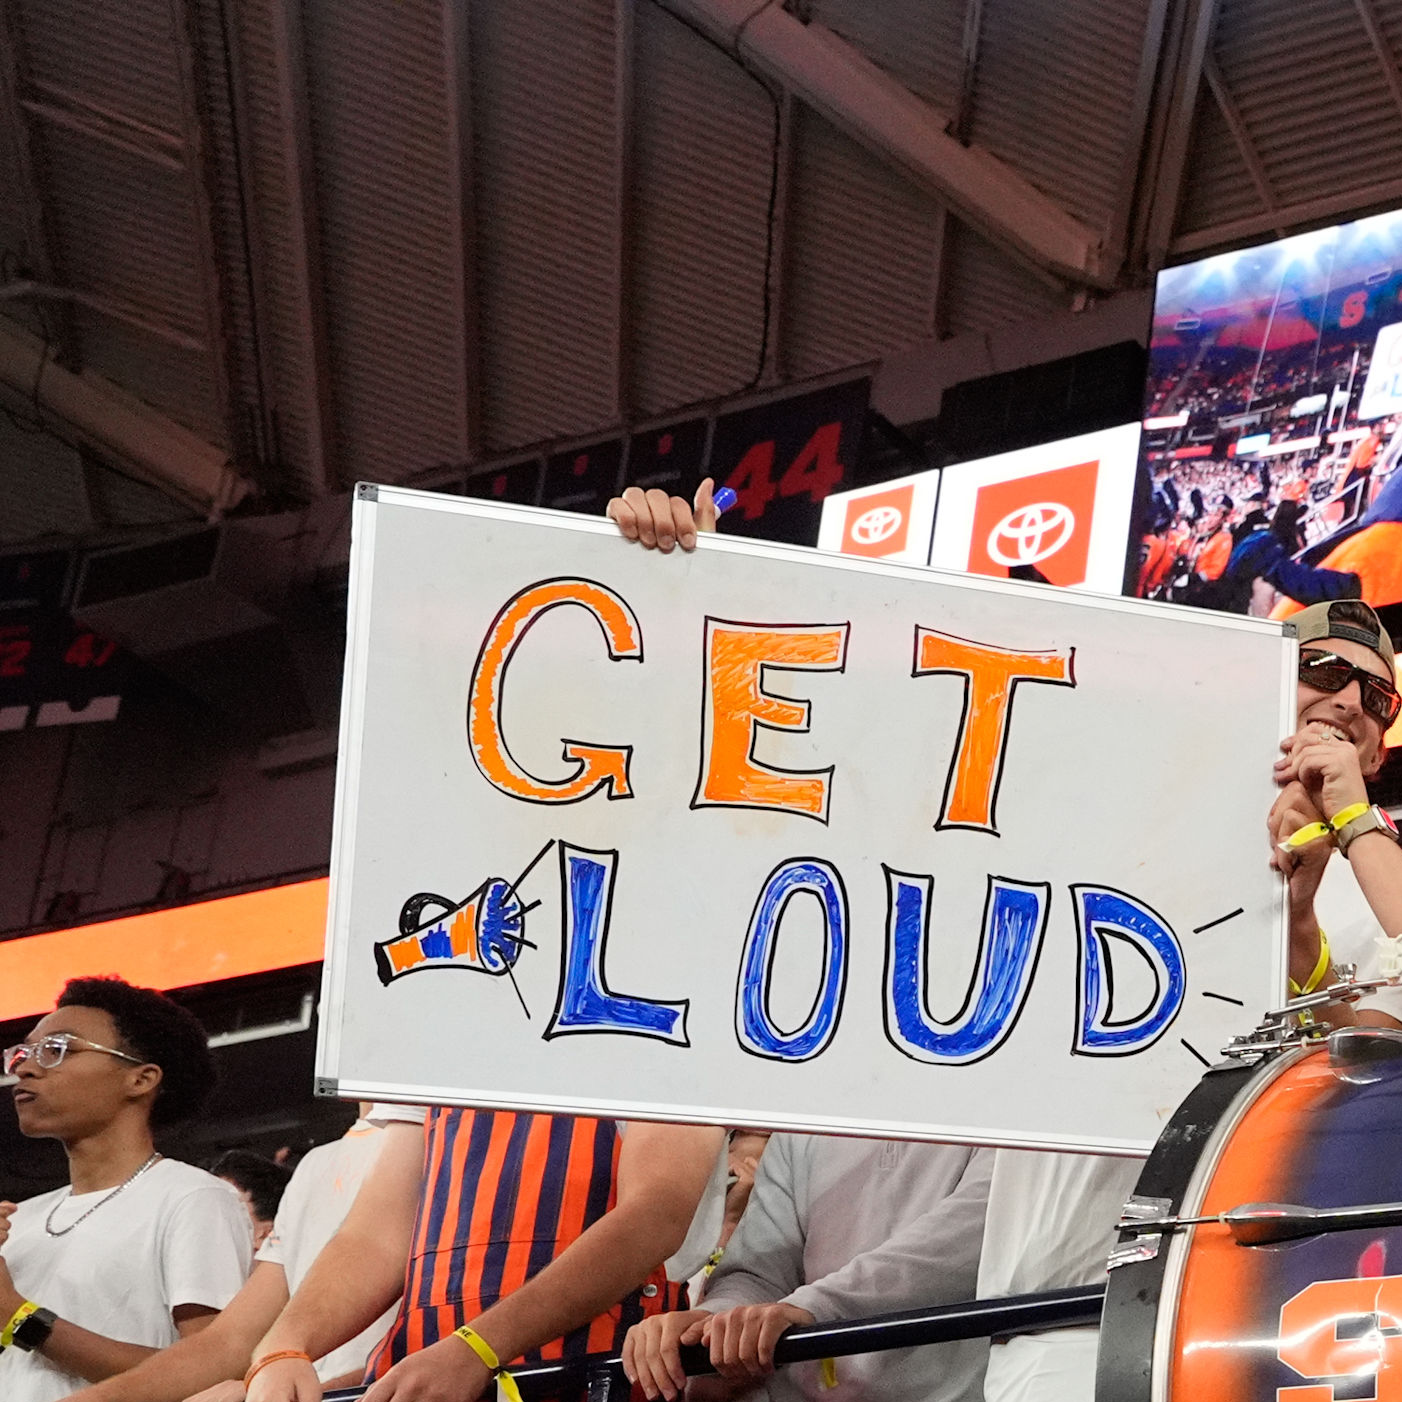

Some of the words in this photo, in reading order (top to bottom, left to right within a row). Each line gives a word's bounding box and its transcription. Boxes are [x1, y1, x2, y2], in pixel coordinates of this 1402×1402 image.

[721, 421, 845, 520] 44
[466, 576, 1077, 838] GET
[541, 840, 1187, 1067] LOUD
